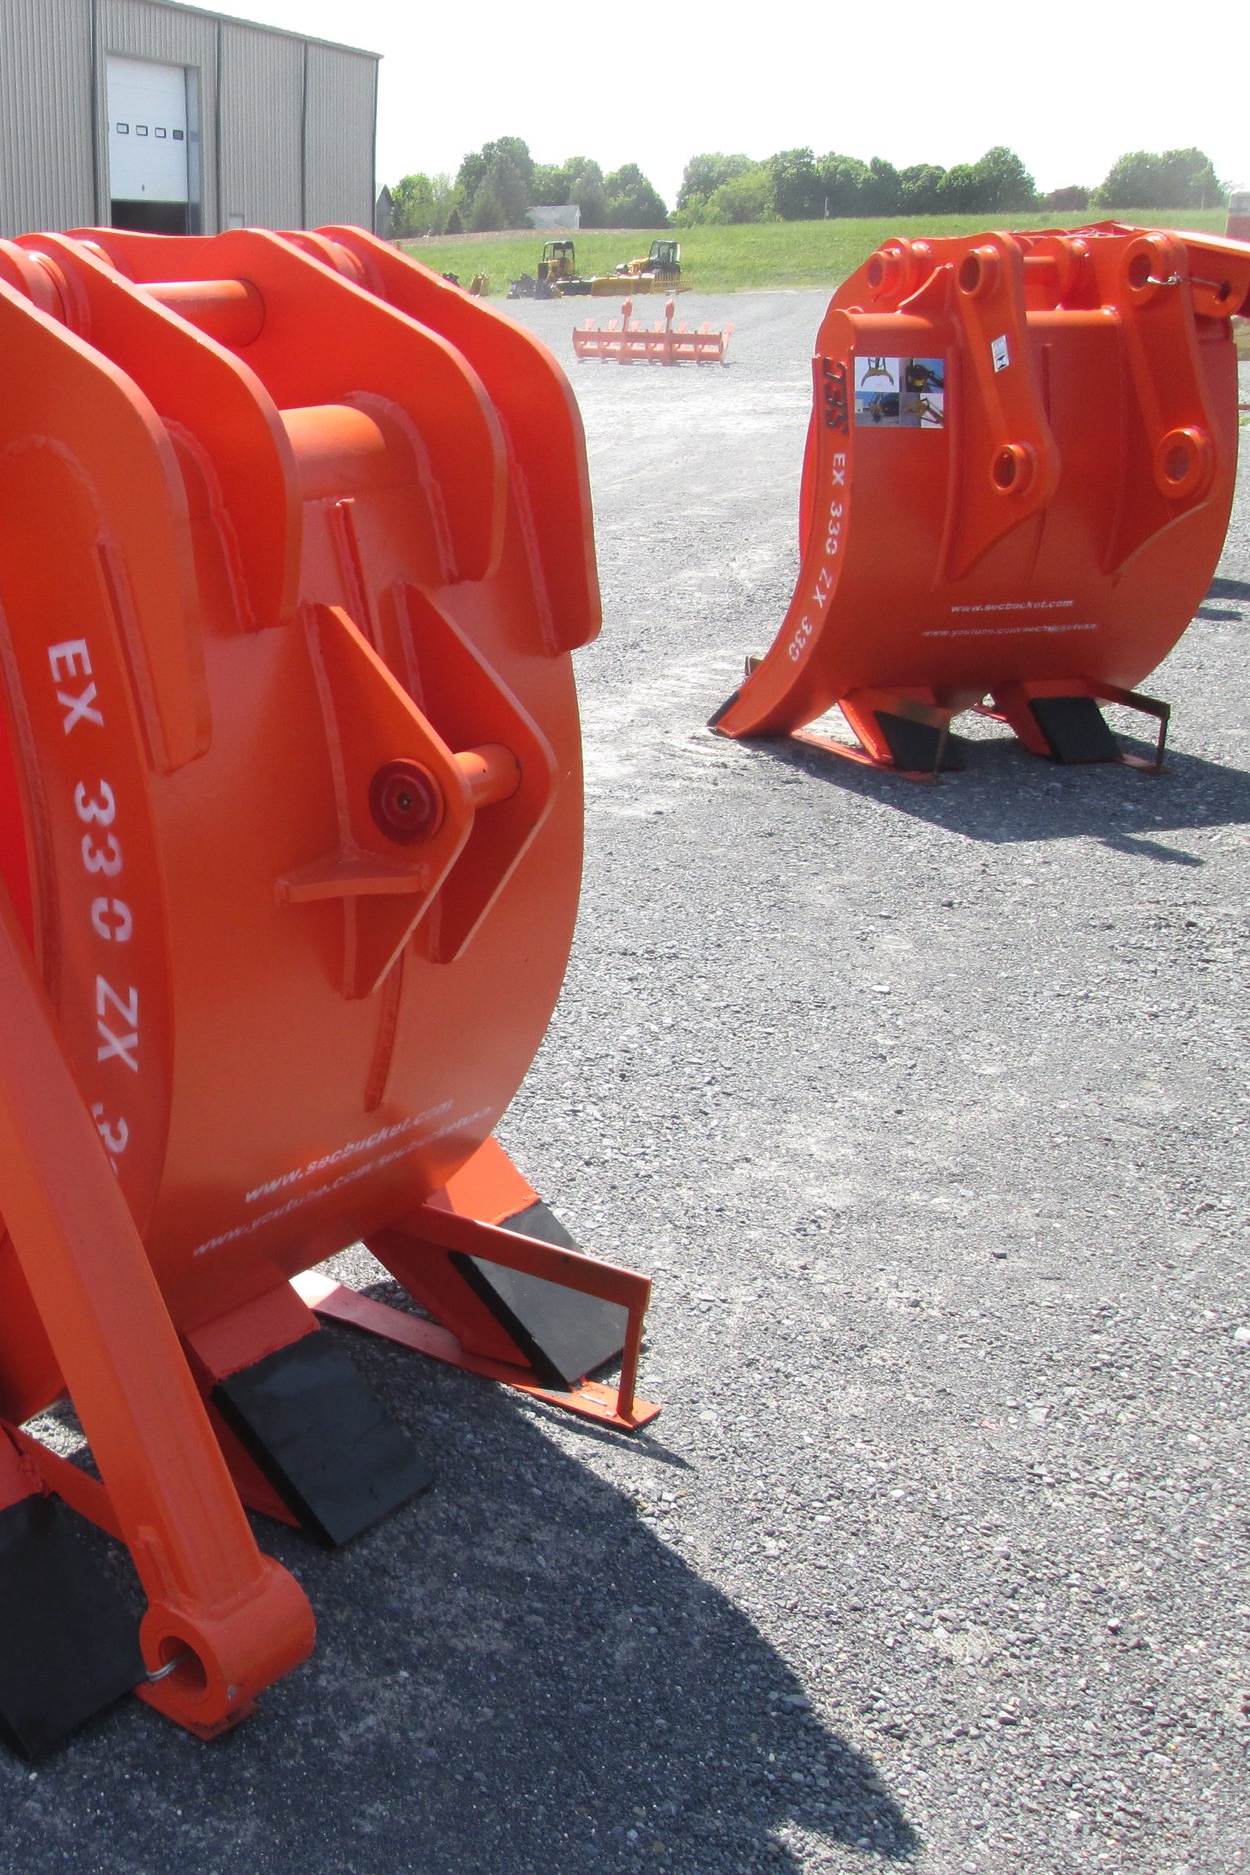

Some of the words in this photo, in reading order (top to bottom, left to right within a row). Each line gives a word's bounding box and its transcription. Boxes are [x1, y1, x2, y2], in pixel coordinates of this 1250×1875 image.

[823, 356, 848, 434] SEC
[832, 453, 846, 486] EX
[825, 501, 843, 555] 330
[812, 567, 833, 609] ZX
[788, 615, 813, 662] 330
[47, 638, 104, 736] EX
[73, 779, 133, 942] 330
[95, 974, 139, 1073] ZX
[91, 1102, 129, 1176] 3
[245, 1099, 454, 1204] www.secbucket.com
